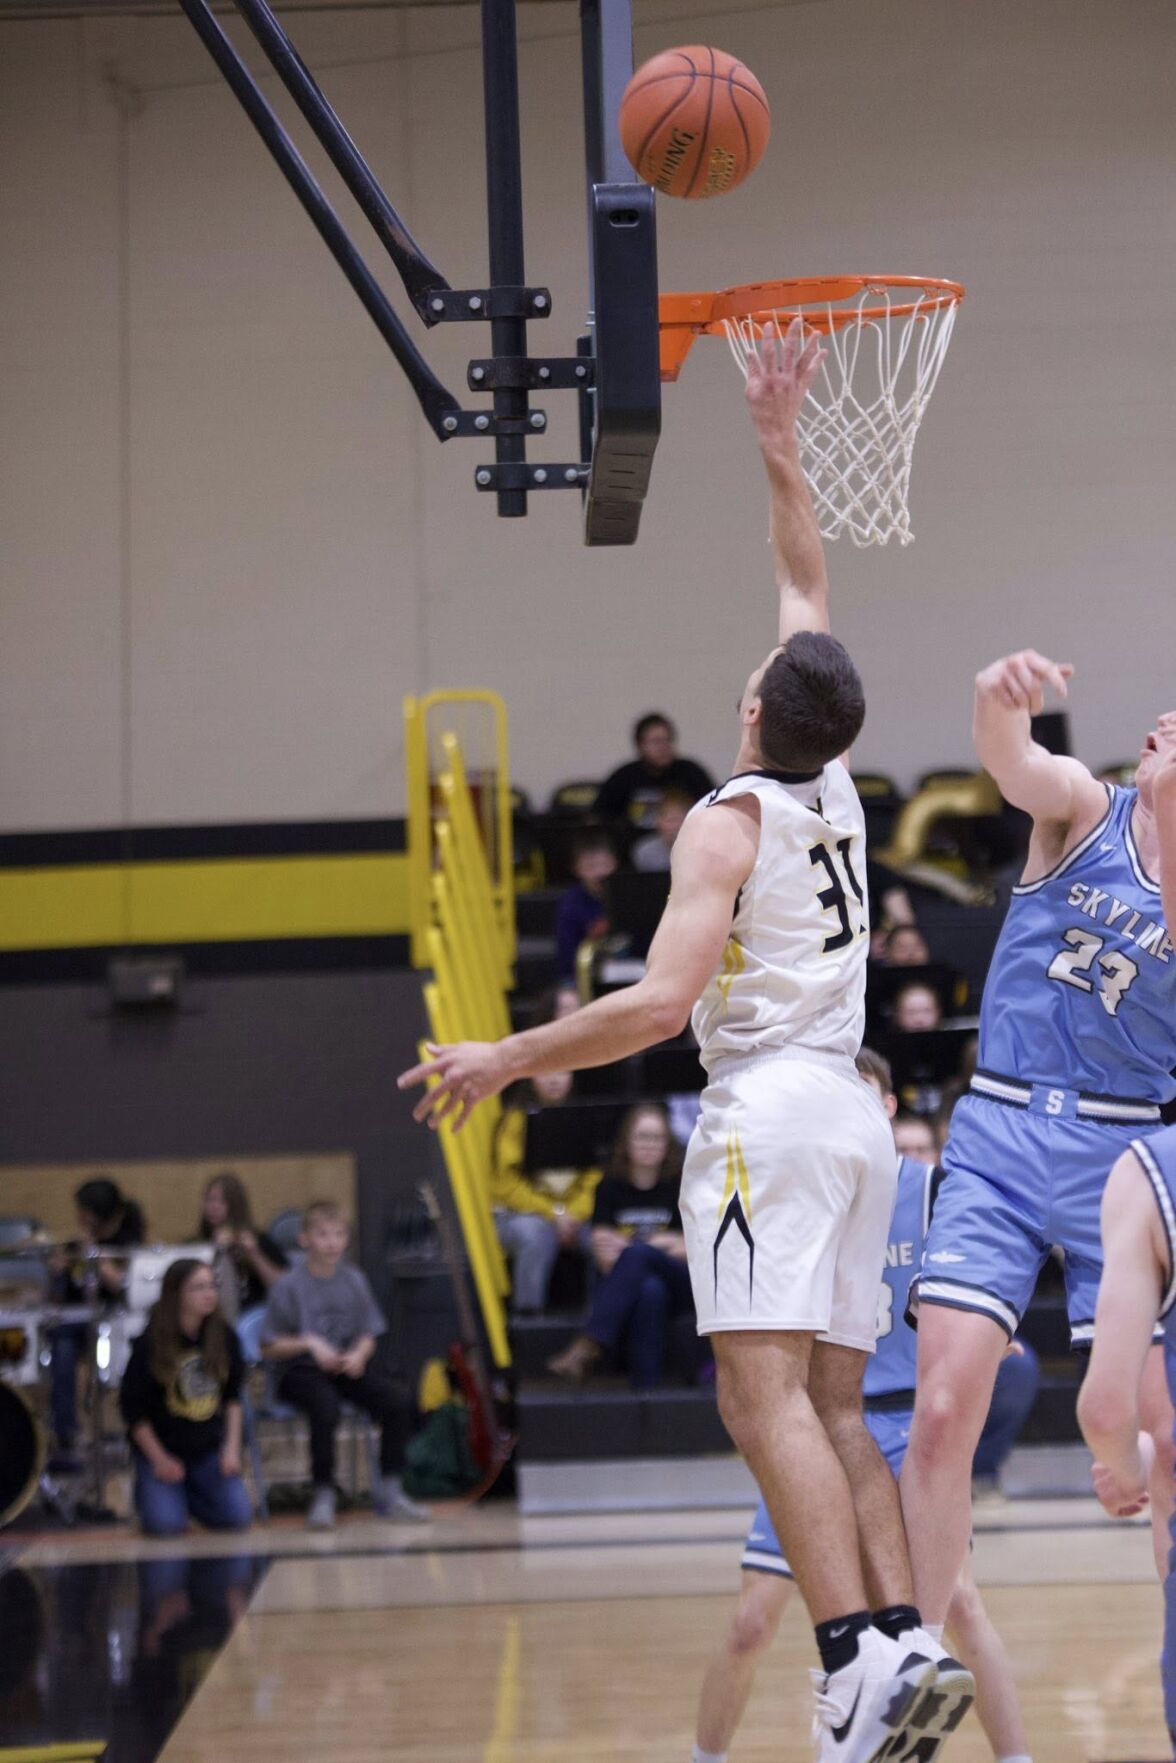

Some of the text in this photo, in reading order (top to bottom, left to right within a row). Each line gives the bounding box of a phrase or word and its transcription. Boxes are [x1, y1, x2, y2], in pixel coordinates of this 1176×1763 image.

[807, 837, 867, 954] 31
[1046, 927, 1139, 1017] 23
[1045, 1090, 1065, 1115] S
